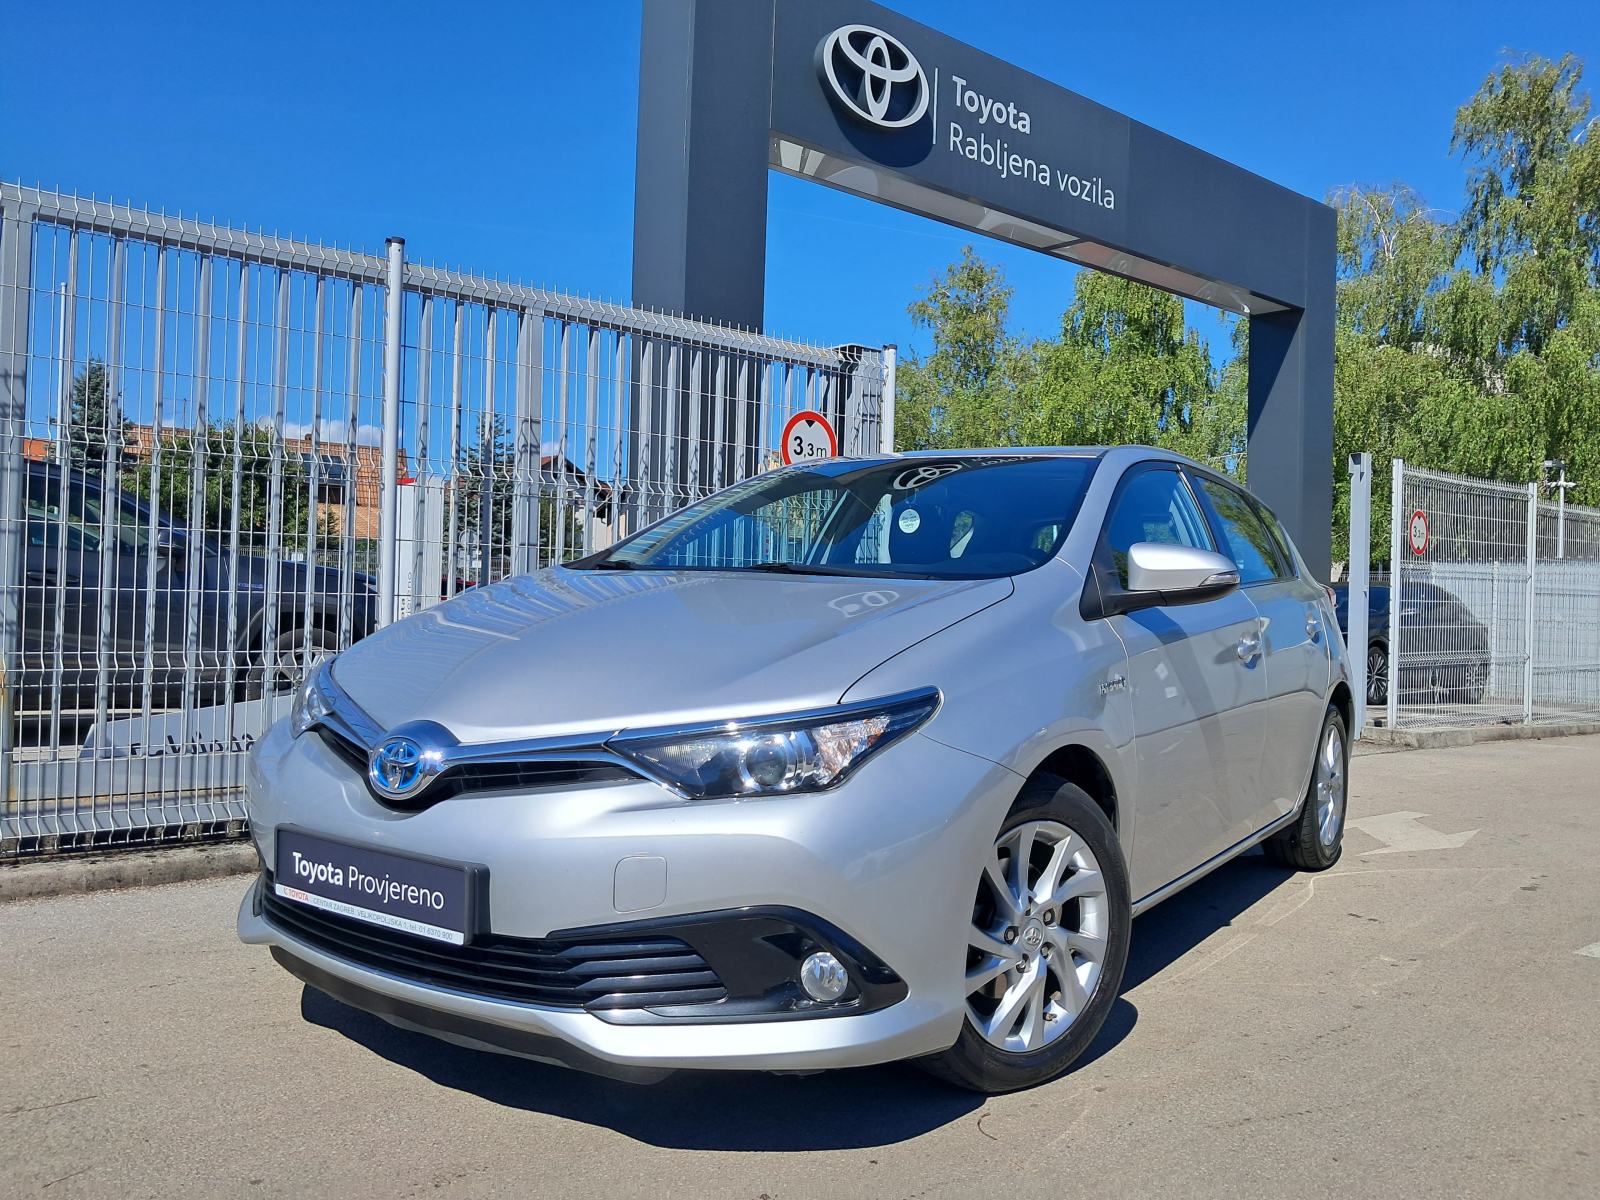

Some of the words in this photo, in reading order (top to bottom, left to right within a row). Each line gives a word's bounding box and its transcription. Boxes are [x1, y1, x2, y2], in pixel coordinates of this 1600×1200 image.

[952, 75, 1031, 134] Toyota
[950, 122, 1050, 186] Rabljena
[1057, 170, 1115, 210] vozila
[289, 888, 309, 901] TOYOTA
[313, 897, 333, 909] CENTAR
[292, 851, 344, 886] Toyota
[348, 866, 445, 910] Provjereno
